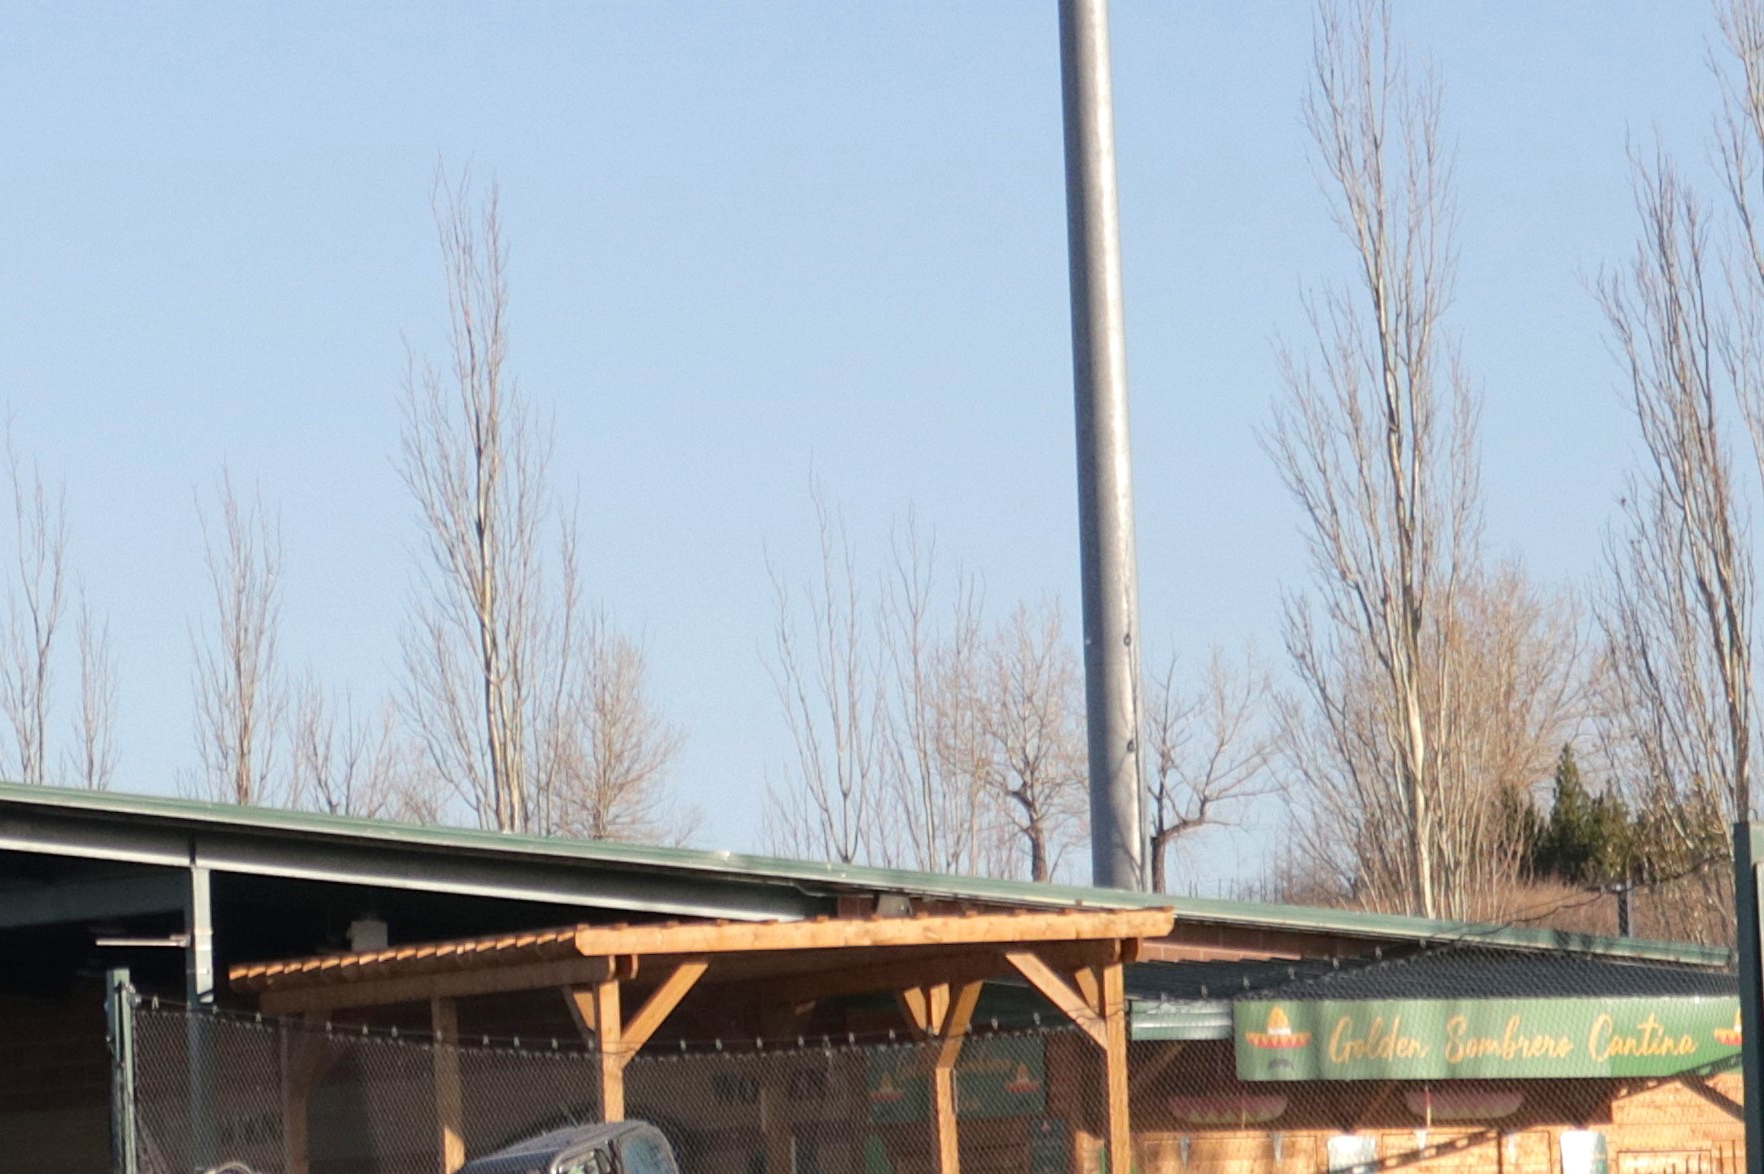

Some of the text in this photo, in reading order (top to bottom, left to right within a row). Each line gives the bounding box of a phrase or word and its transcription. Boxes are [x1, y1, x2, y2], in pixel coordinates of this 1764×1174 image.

[1329, 1013, 1697, 1064] Golden Sombrero Cantina
[711, 1066, 828, 1104] WOEN
